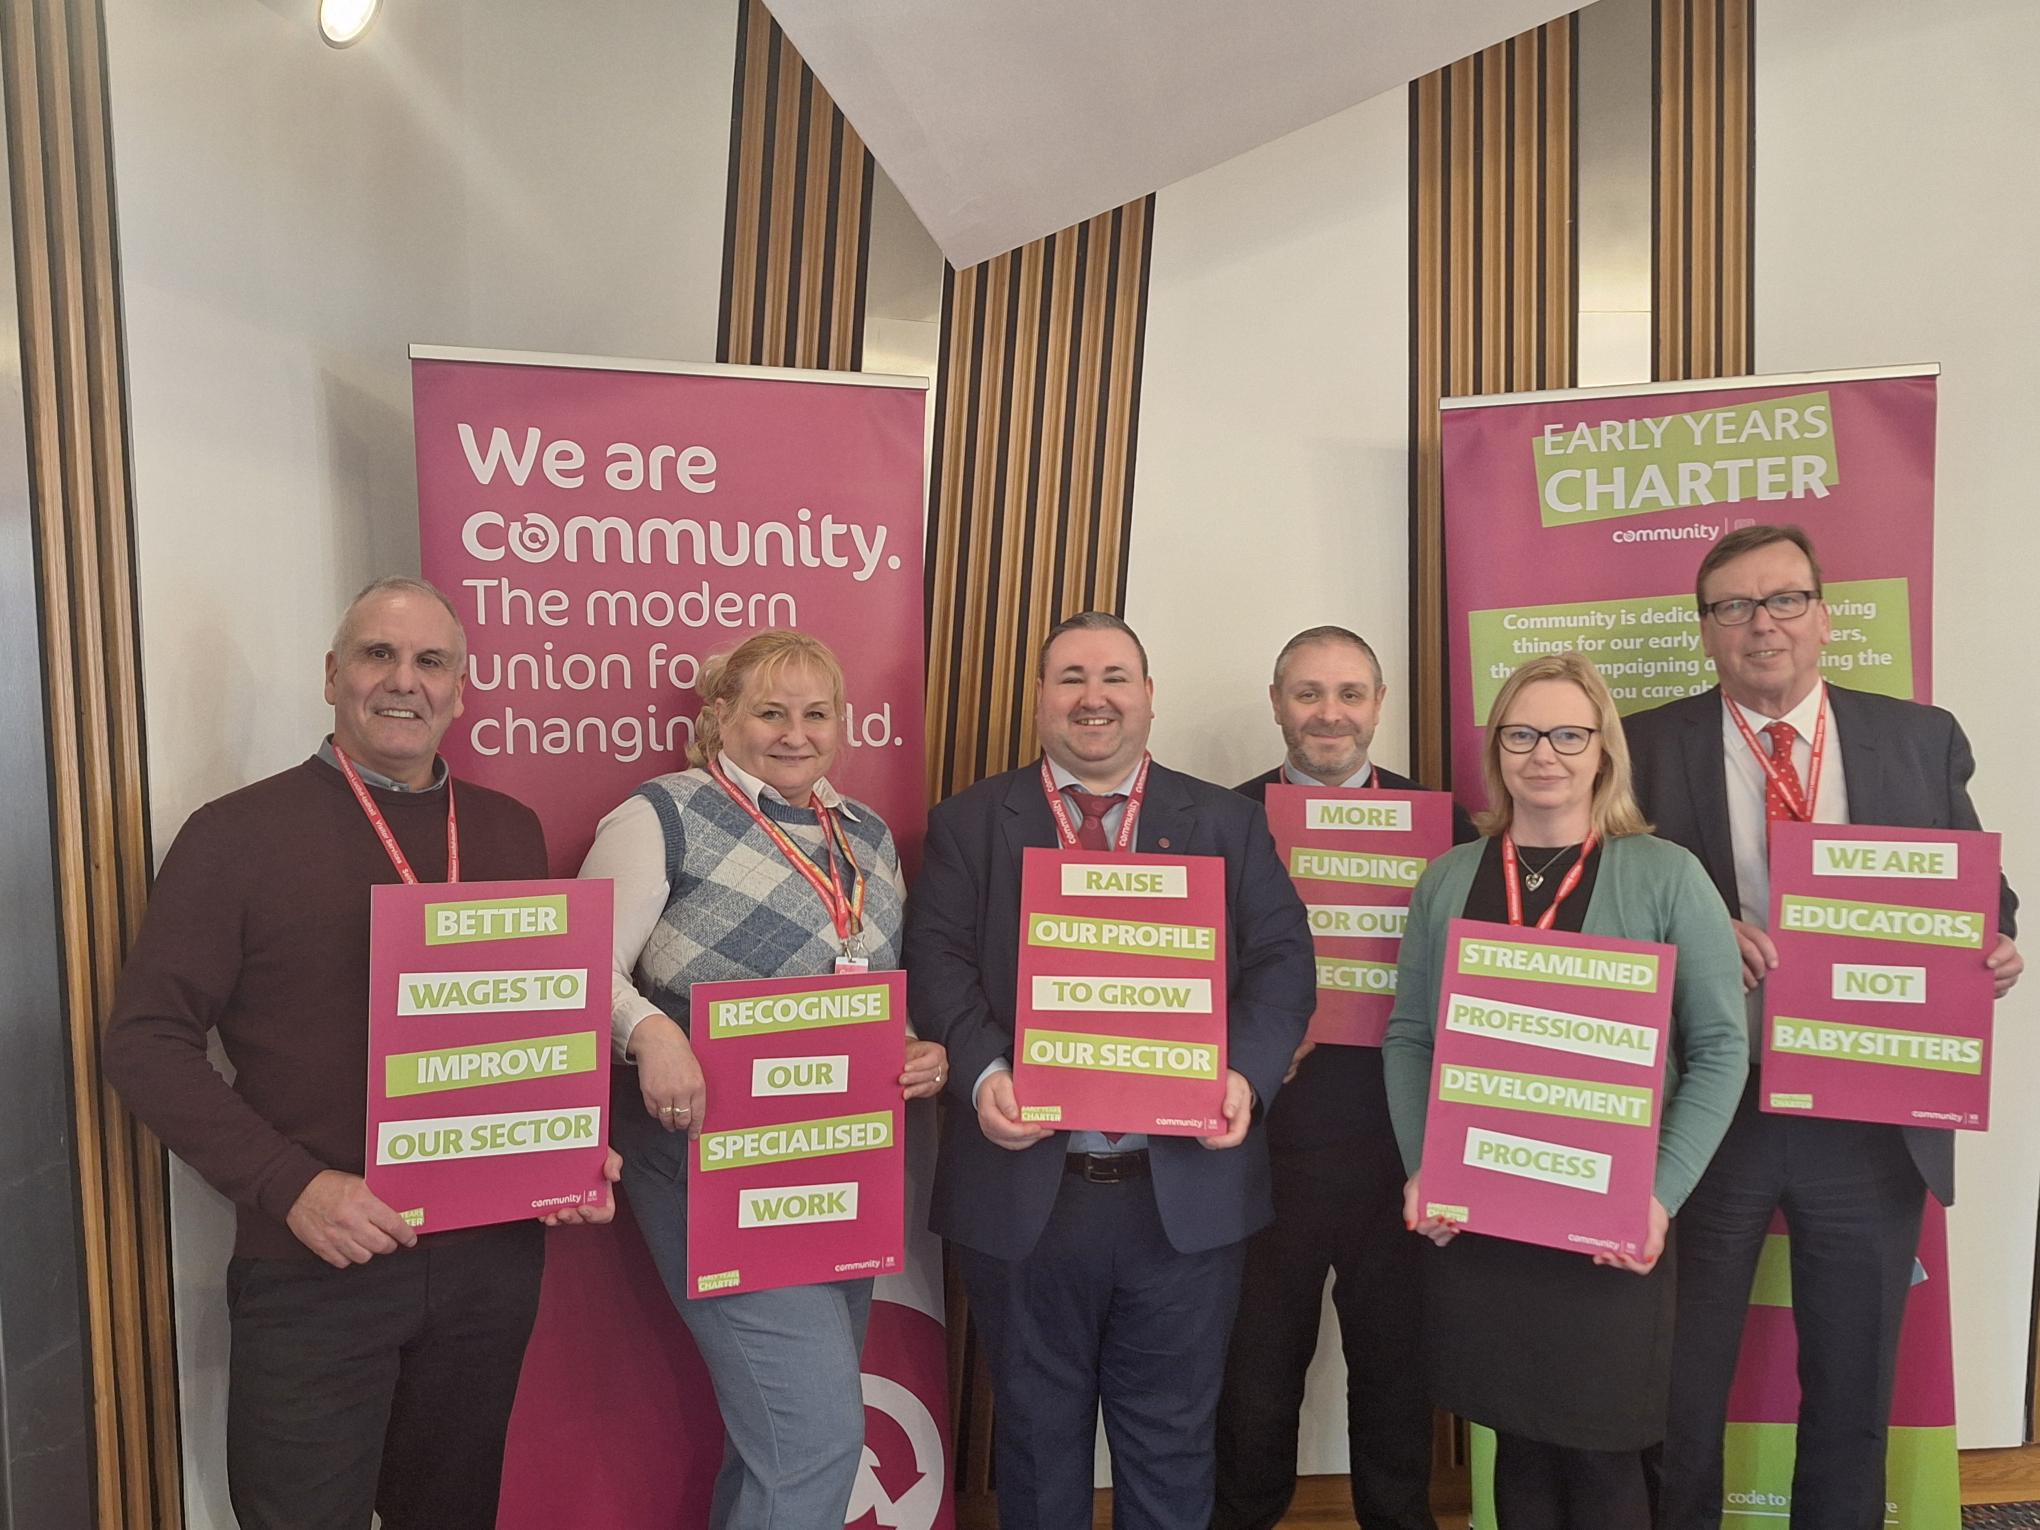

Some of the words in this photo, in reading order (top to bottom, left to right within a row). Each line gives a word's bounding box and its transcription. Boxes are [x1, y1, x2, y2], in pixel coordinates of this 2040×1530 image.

[1543, 415, 1672, 456] EARLY
[1682, 405, 1828, 446] YEARS
[457, 422, 585, 489] We
[604, 442, 718, 493] are
[1544, 455, 1831, 513] CHARTER
[461, 507, 901, 581] community.
[1612, 523, 1719, 543] community
[462, 578, 569, 627] The
[586, 580, 797, 628] modern
[1503, 610, 1616, 631] Community
[1620, 609, 1636, 626] is
[1512, 637, 1573, 656] things
[1577, 635, 1608, 651] for
[1610, 636, 1643, 650] our
[1648, 631, 1700, 652] early
[468, 641, 631, 691] union
[649, 642, 703, 691] fo
[1594, 657, 1700, 679] mpaigning
[1857, 648, 1893, 666] the
[1641, 684, 1685, 699] care
[471, 704, 696, 763] changin
[842, 702, 903, 748] ld.
[1051, 799, 1077, 845] community
[1118, 798, 1141, 847] community
[1319, 805, 1397, 827] MORE
[1296, 854, 1418, 880] FUNDING
[1826, 847, 1877, 870] WE
[1882, 850, 1944, 875] ARE
[1085, 870, 1164, 893] RAISE
[436, 906, 559, 937] BETTER
[1034, 919, 1098, 945] OUR
[1101, 923, 1211, 951] PROFILE
[1308, 909, 1352, 931] OR
[1784, 903, 1980, 943] EDUCATORS,
[1463, 943, 1655, 987] STREAMLINED
[408, 975, 528, 1010] WAGES
[531, 973, 580, 1002] TO
[1051, 980, 1093, 1004] TO
[1098, 983, 1192, 1009] GROW
[1844, 970, 1915, 997] NOT
[718, 992, 882, 1028] RECOGNISE
[1452, 1003, 1652, 1051] PROFESSIONAL
[1029, 1039, 1096, 1066] OUR
[1099, 1043, 1213, 1072] SECTOR
[1774, 1024, 1981, 1064] BABYSITTERS
[416, 1045, 568, 1084] IMPROVE
[766, 1062, 834, 1090] OUR
[1442, 1067, 1648, 1120] DEVELOPMENT
[386, 1128, 465, 1160] OUR
[469, 1113, 594, 1152] SECTOR
[707, 1121, 889, 1162] SPECIALISED
[1475, 1140, 1598, 1180] PROCESS
[530, 1193, 582, 1209] community
[750, 1189, 848, 1223] WORK
[834, 1259, 881, 1273] community
[1727, 1490, 1766, 1505] code
[1768, 1492, 1786, 1506] to
